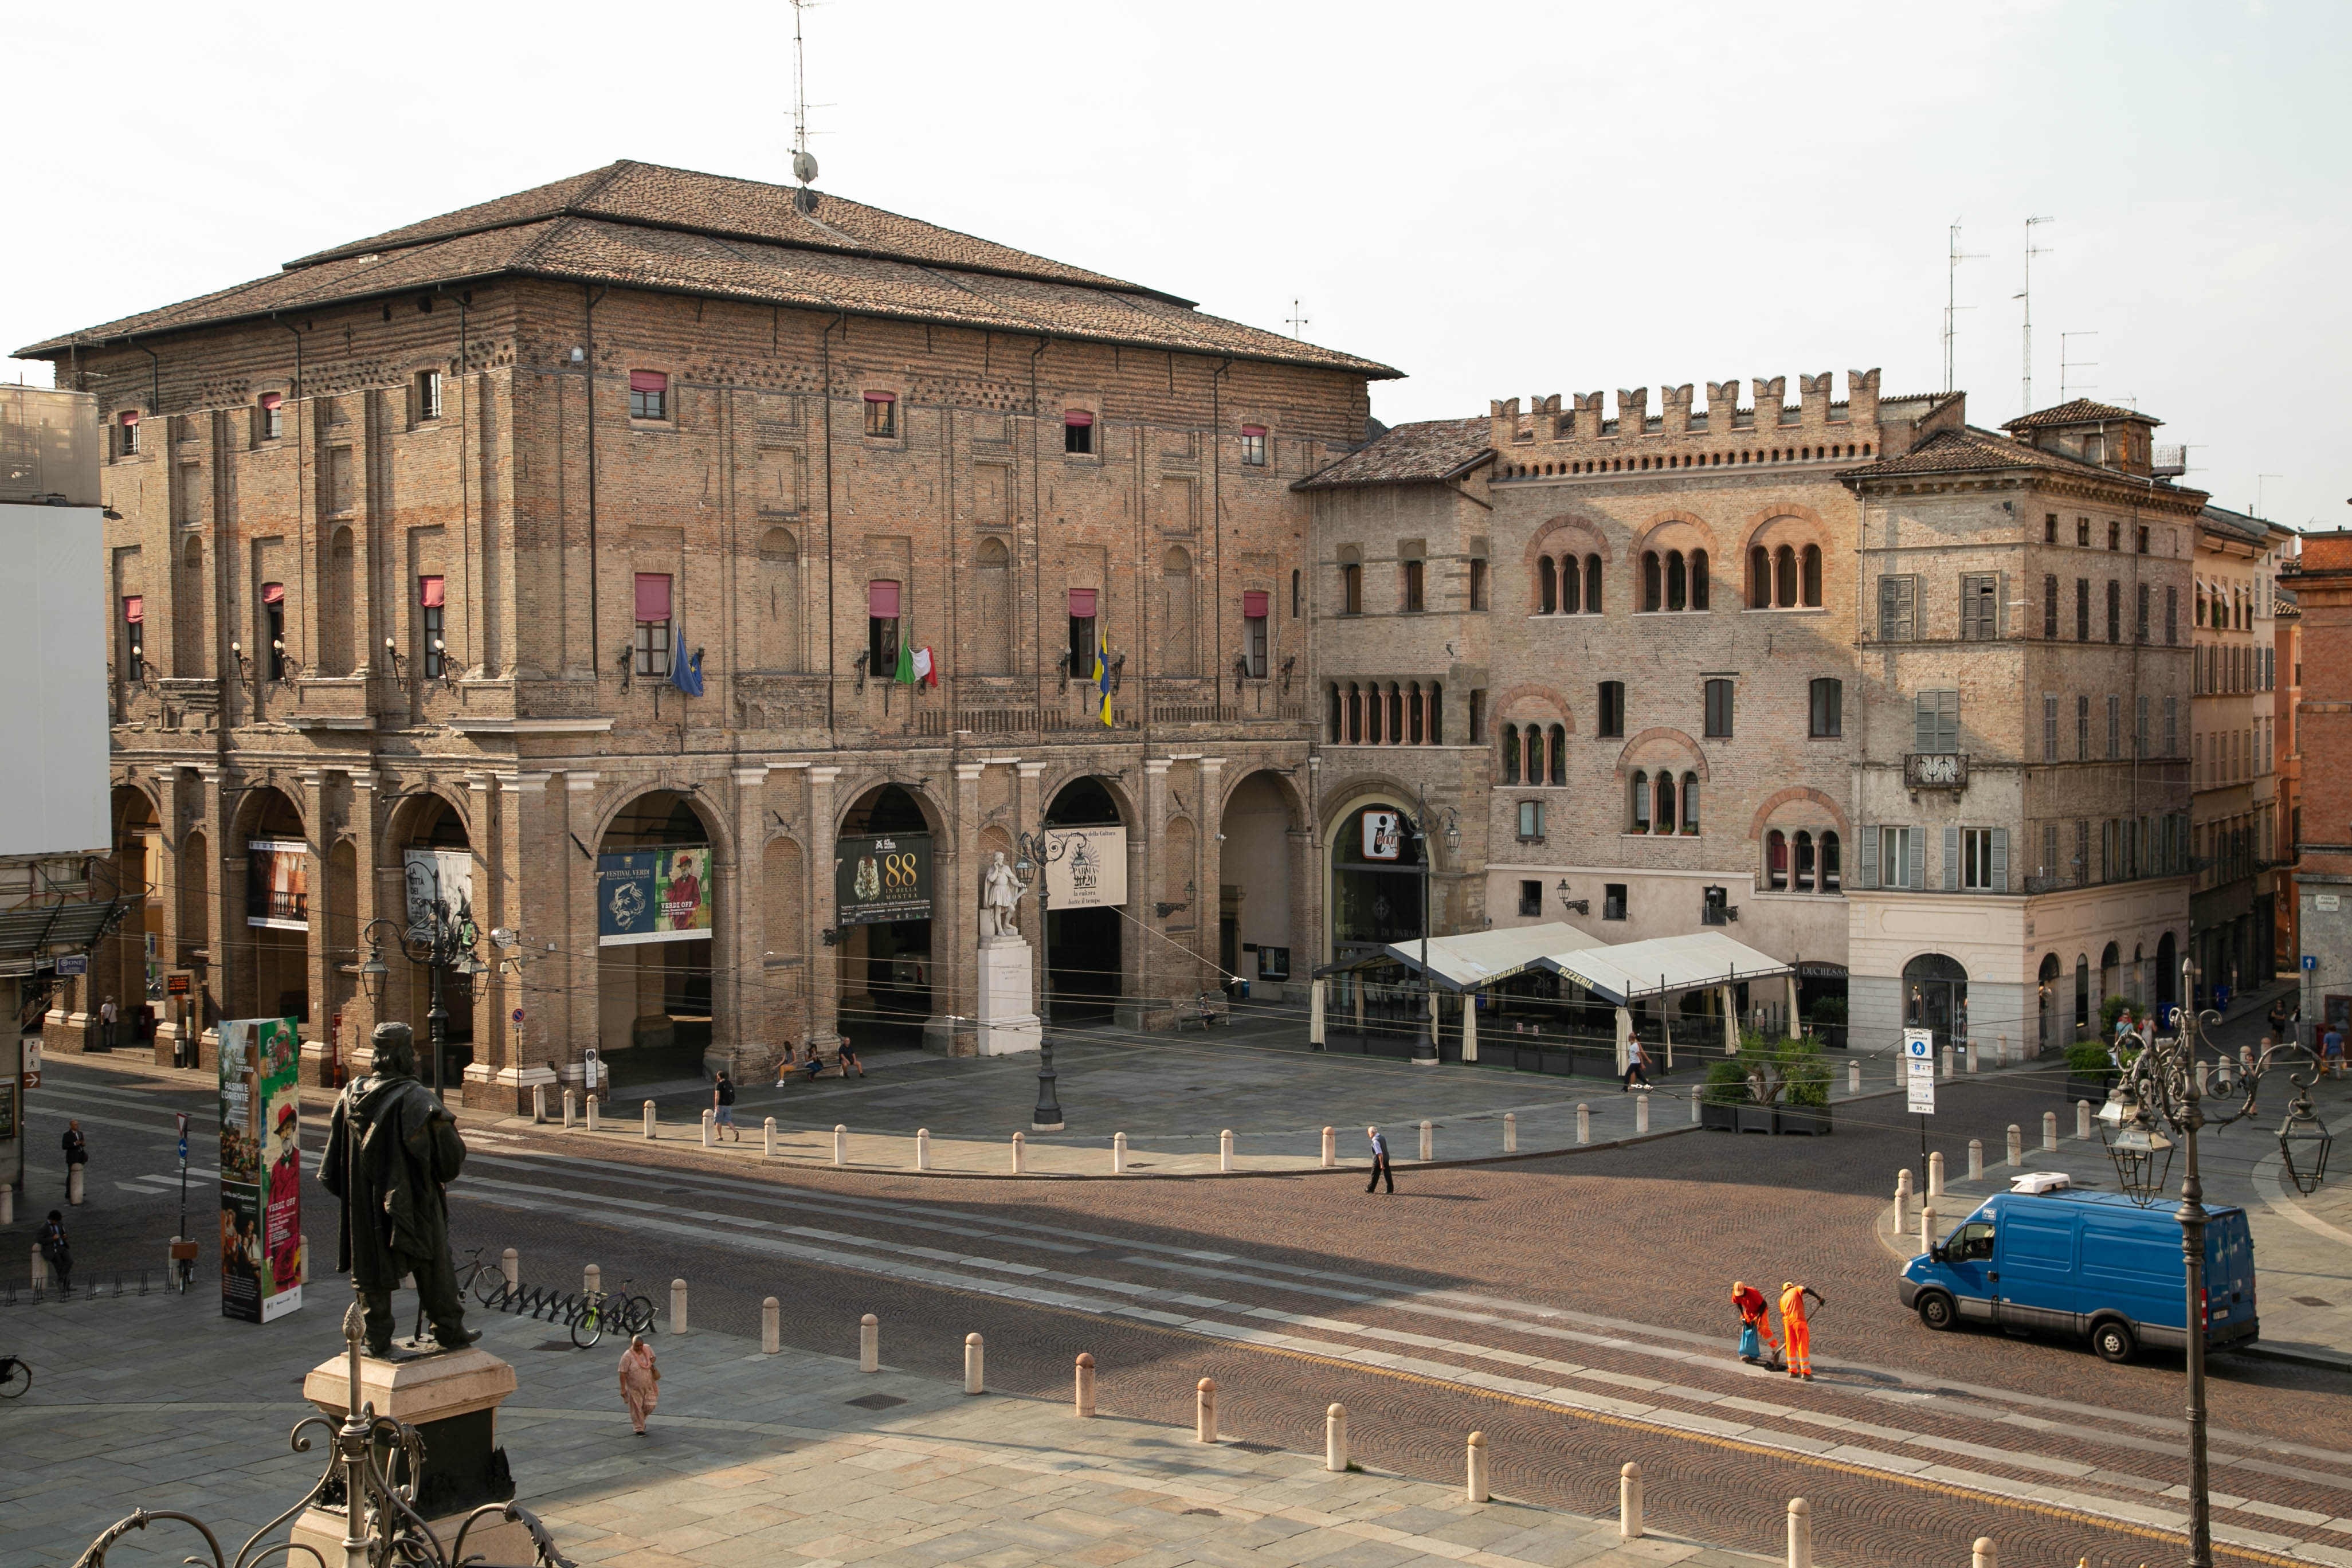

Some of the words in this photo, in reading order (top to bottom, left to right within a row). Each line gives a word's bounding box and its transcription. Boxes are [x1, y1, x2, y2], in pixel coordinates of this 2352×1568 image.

[885, 853, 917, 888] 88
[1074, 875, 1096, 887] 2020
[1480, 964, 1526, 986] RISTORANTE
[1558, 967, 1594, 990] PIZZERIA
[1802, 966, 1848, 977] DUCHESSA
[225, 1081, 244, 1092] PASINI
[245, 1084, 248, 1092] E
